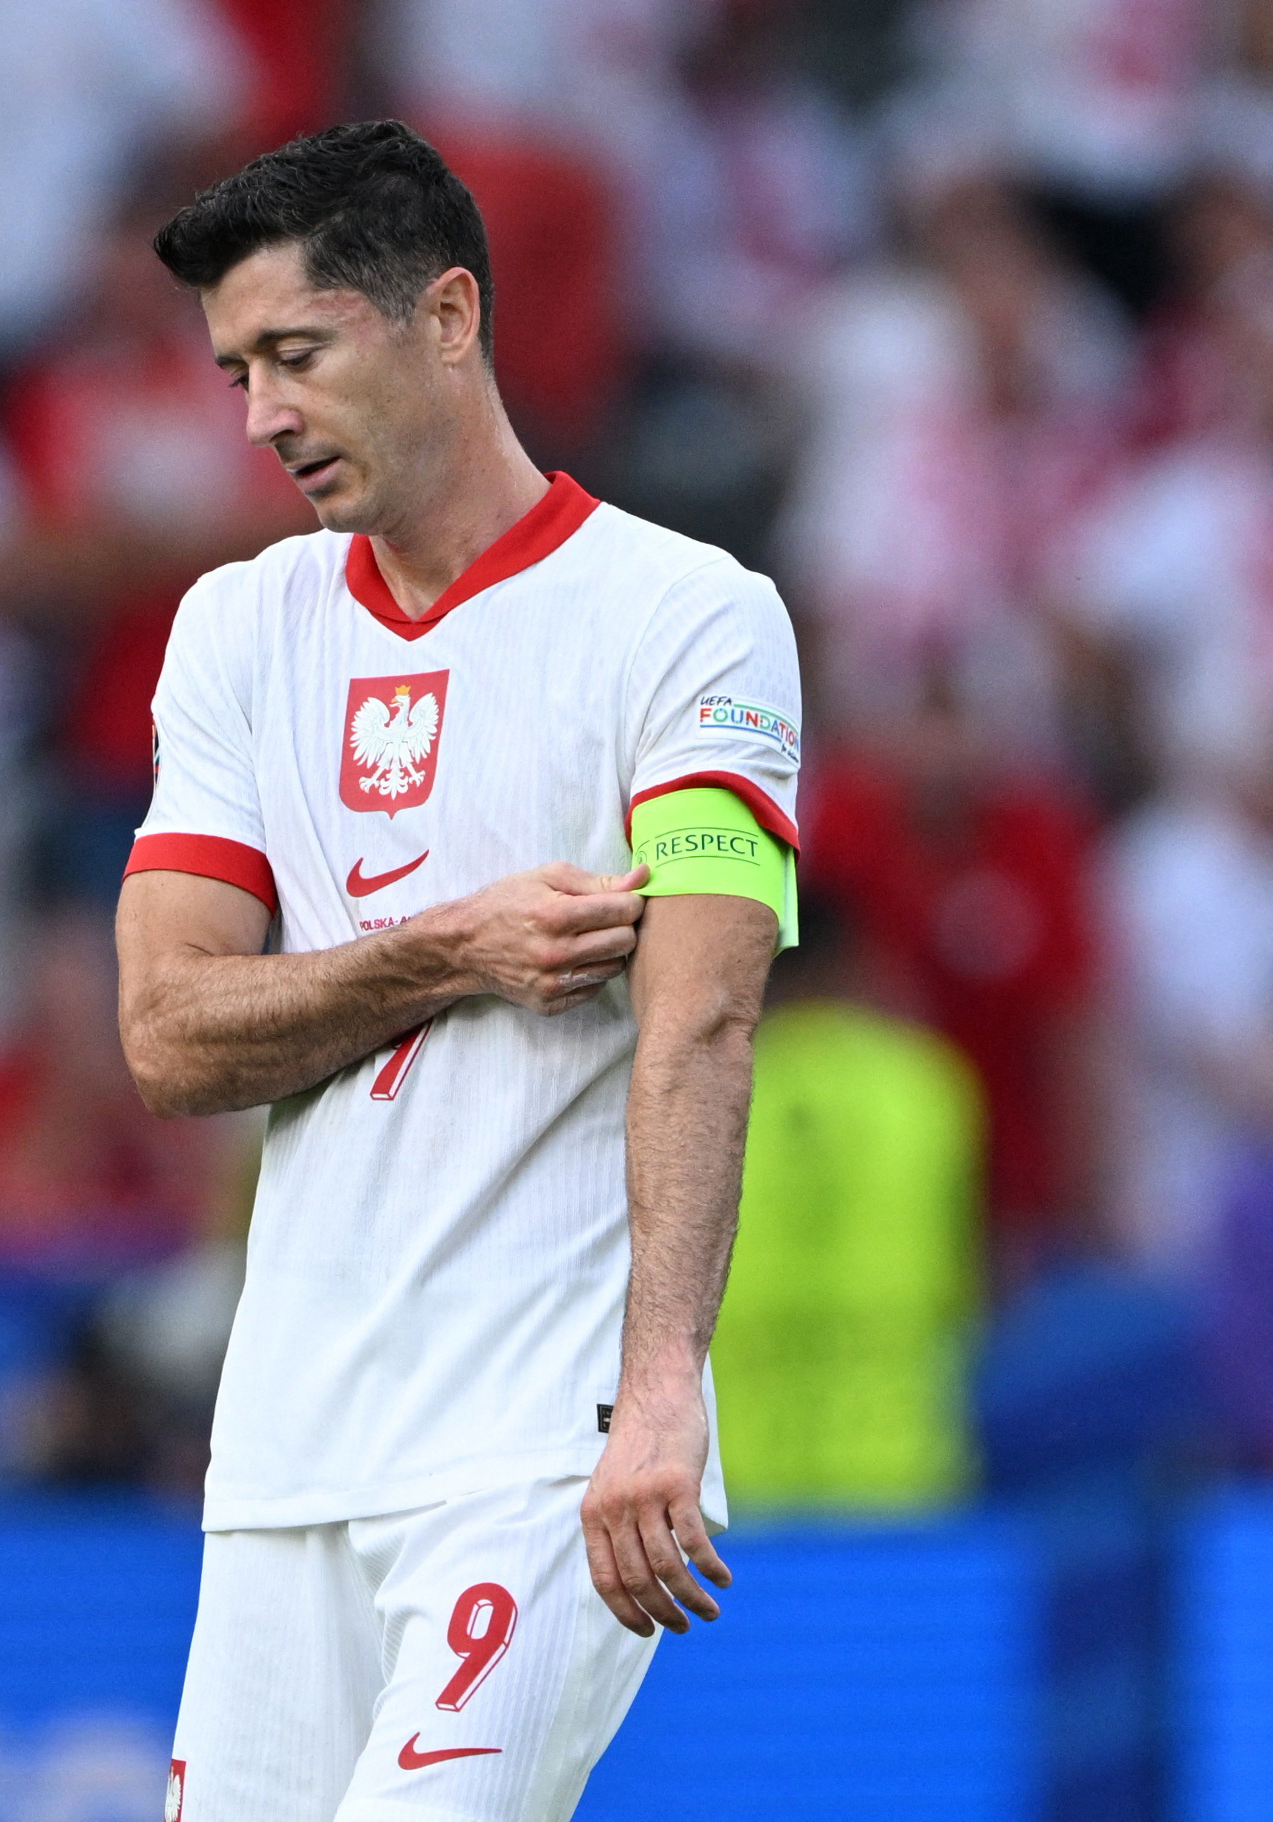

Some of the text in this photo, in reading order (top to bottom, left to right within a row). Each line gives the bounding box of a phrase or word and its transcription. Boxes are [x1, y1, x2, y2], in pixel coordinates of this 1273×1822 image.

[700, 696, 732, 706] UEFA
[656, 834, 759, 860] RESPECT
[435, 1582, 519, 1713] 9
